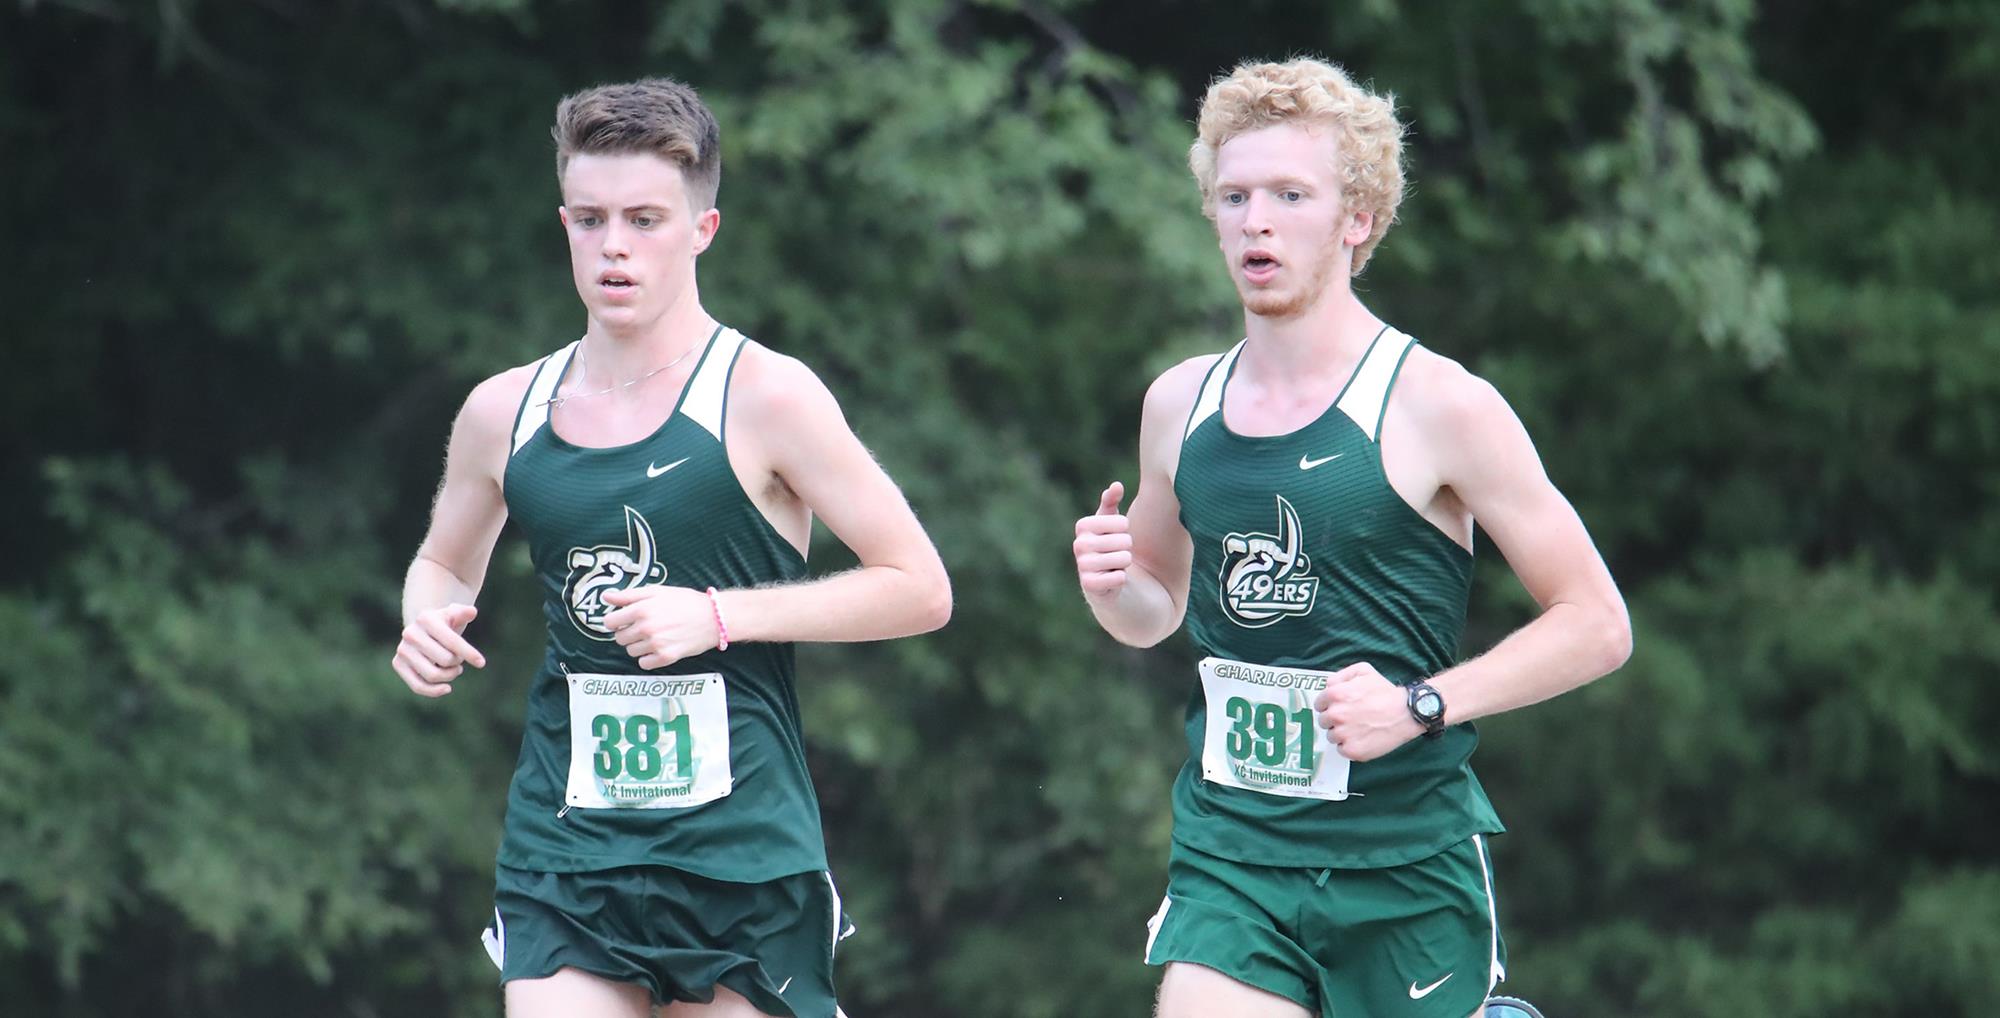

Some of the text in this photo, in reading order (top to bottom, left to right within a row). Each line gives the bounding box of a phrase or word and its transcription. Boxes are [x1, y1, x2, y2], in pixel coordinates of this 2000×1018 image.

[1230, 574, 1312, 602] 49ERS
[583, 679, 705, 697] CHARLOTTE
[1214, 664, 1328, 691] CHARLOTTE
[1226, 696, 1314, 769] 391
[591, 714, 692, 780] 381
[1234, 764, 1312, 787] XC Invitational
[602, 784, 691, 798] XC Invitational
